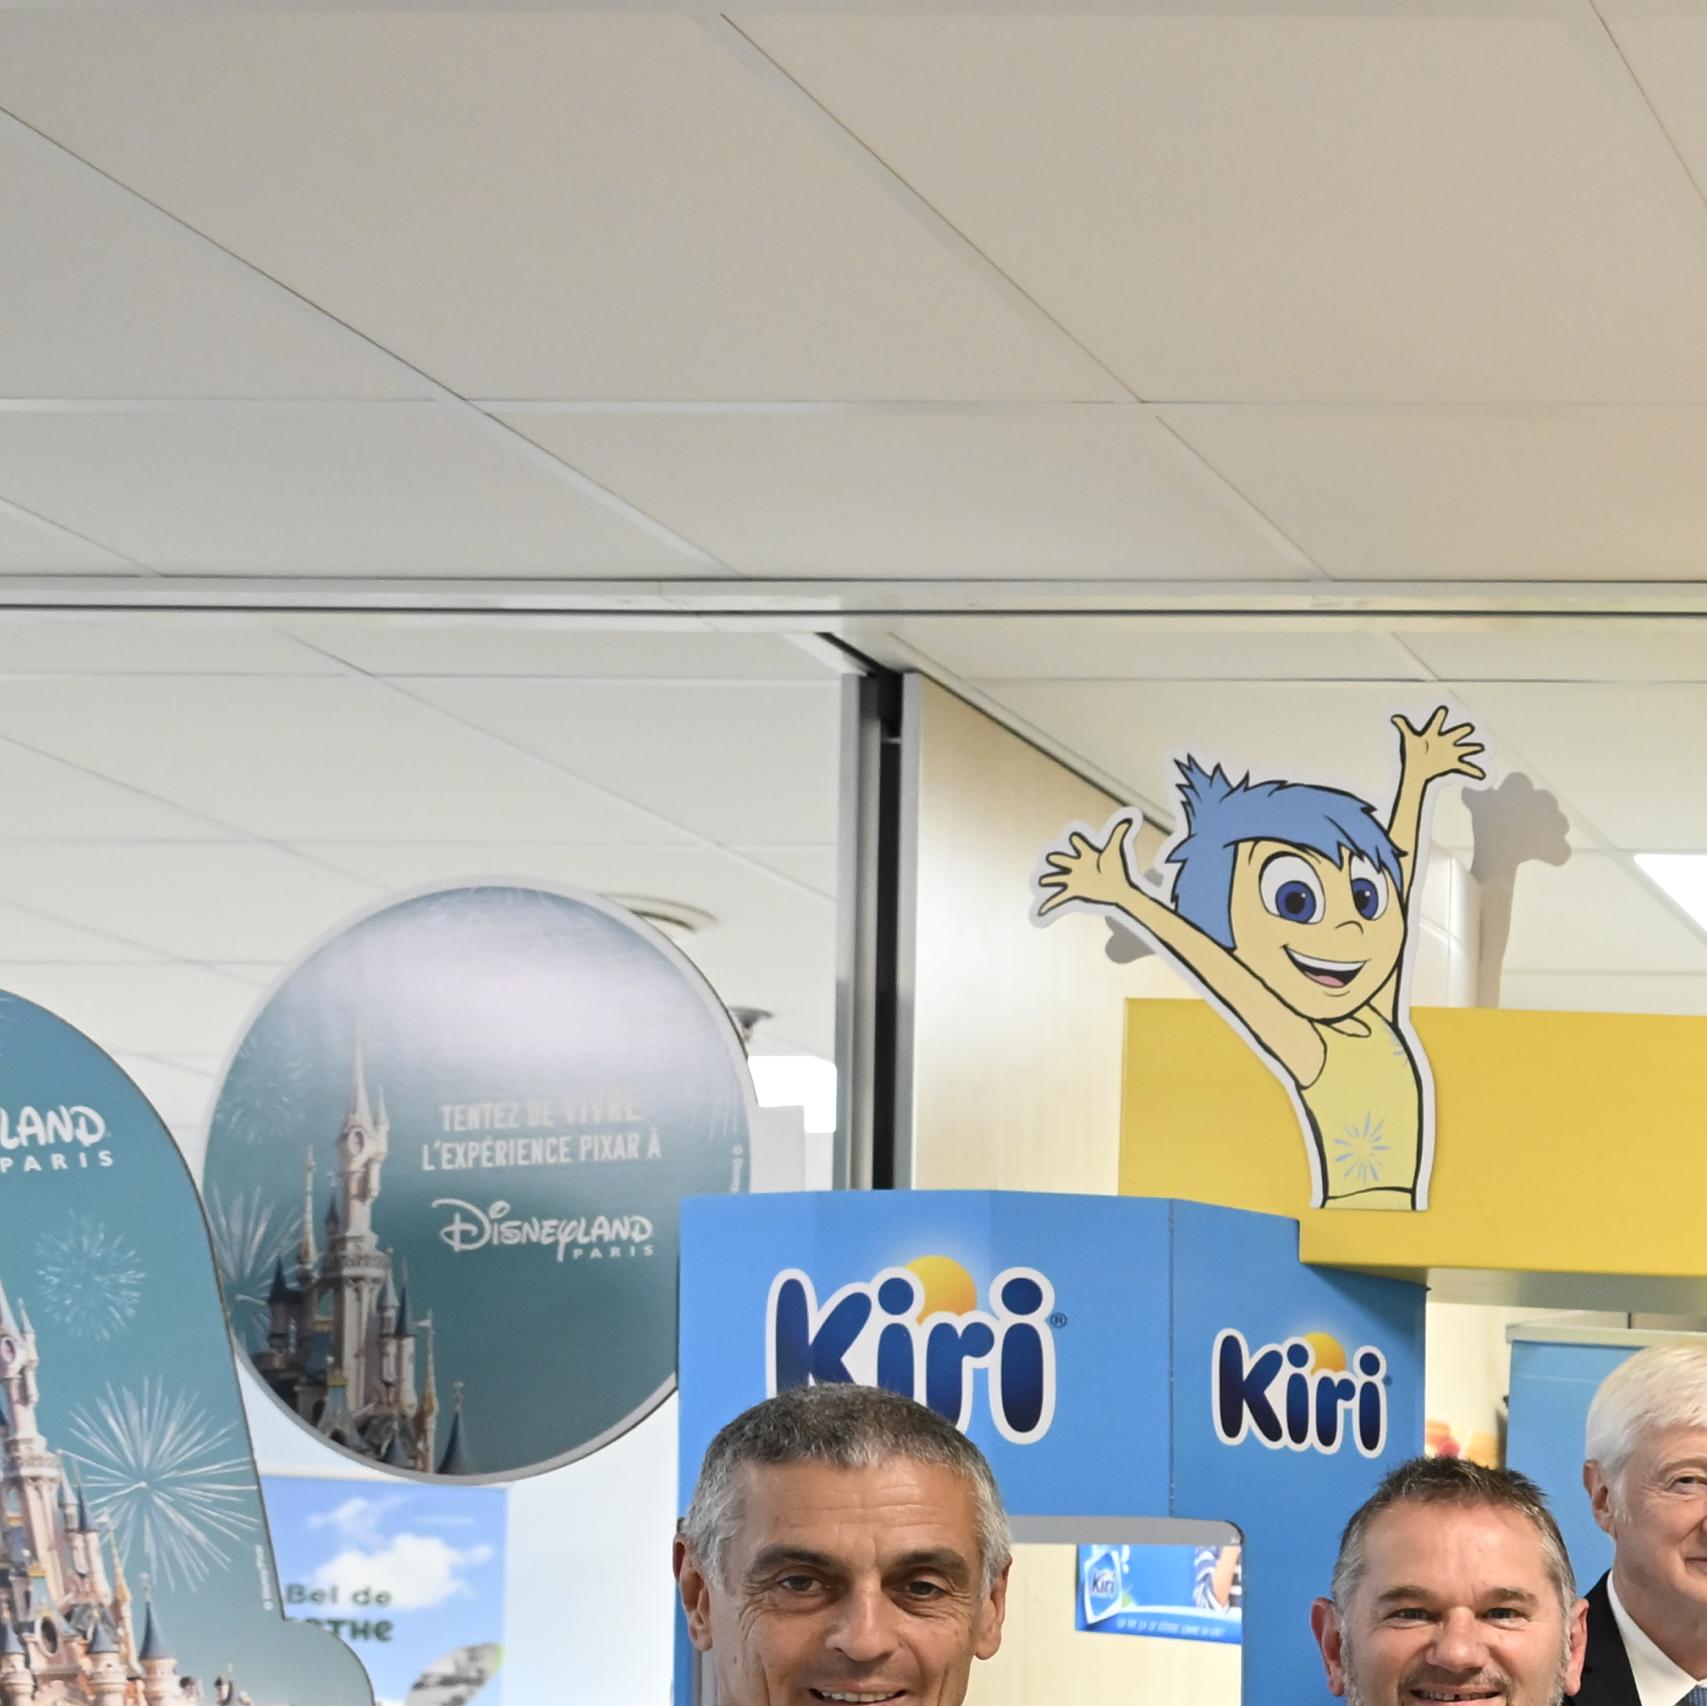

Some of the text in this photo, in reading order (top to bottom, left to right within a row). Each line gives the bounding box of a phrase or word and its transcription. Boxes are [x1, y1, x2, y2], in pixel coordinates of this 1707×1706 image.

[0, 1104, 106, 1149] LAND
[440, 1097, 644, 1132] TENTEZ DE VIVRE
[0, 1150, 113, 1174] PARIS
[422, 1126, 662, 1171] L'EXPÉRIENCE PIXAR À
[573, 1245, 654, 1261] PARIS
[767, 1266, 1056, 1444] Kiri
[1211, 1328, 1389, 1459] Kiri
